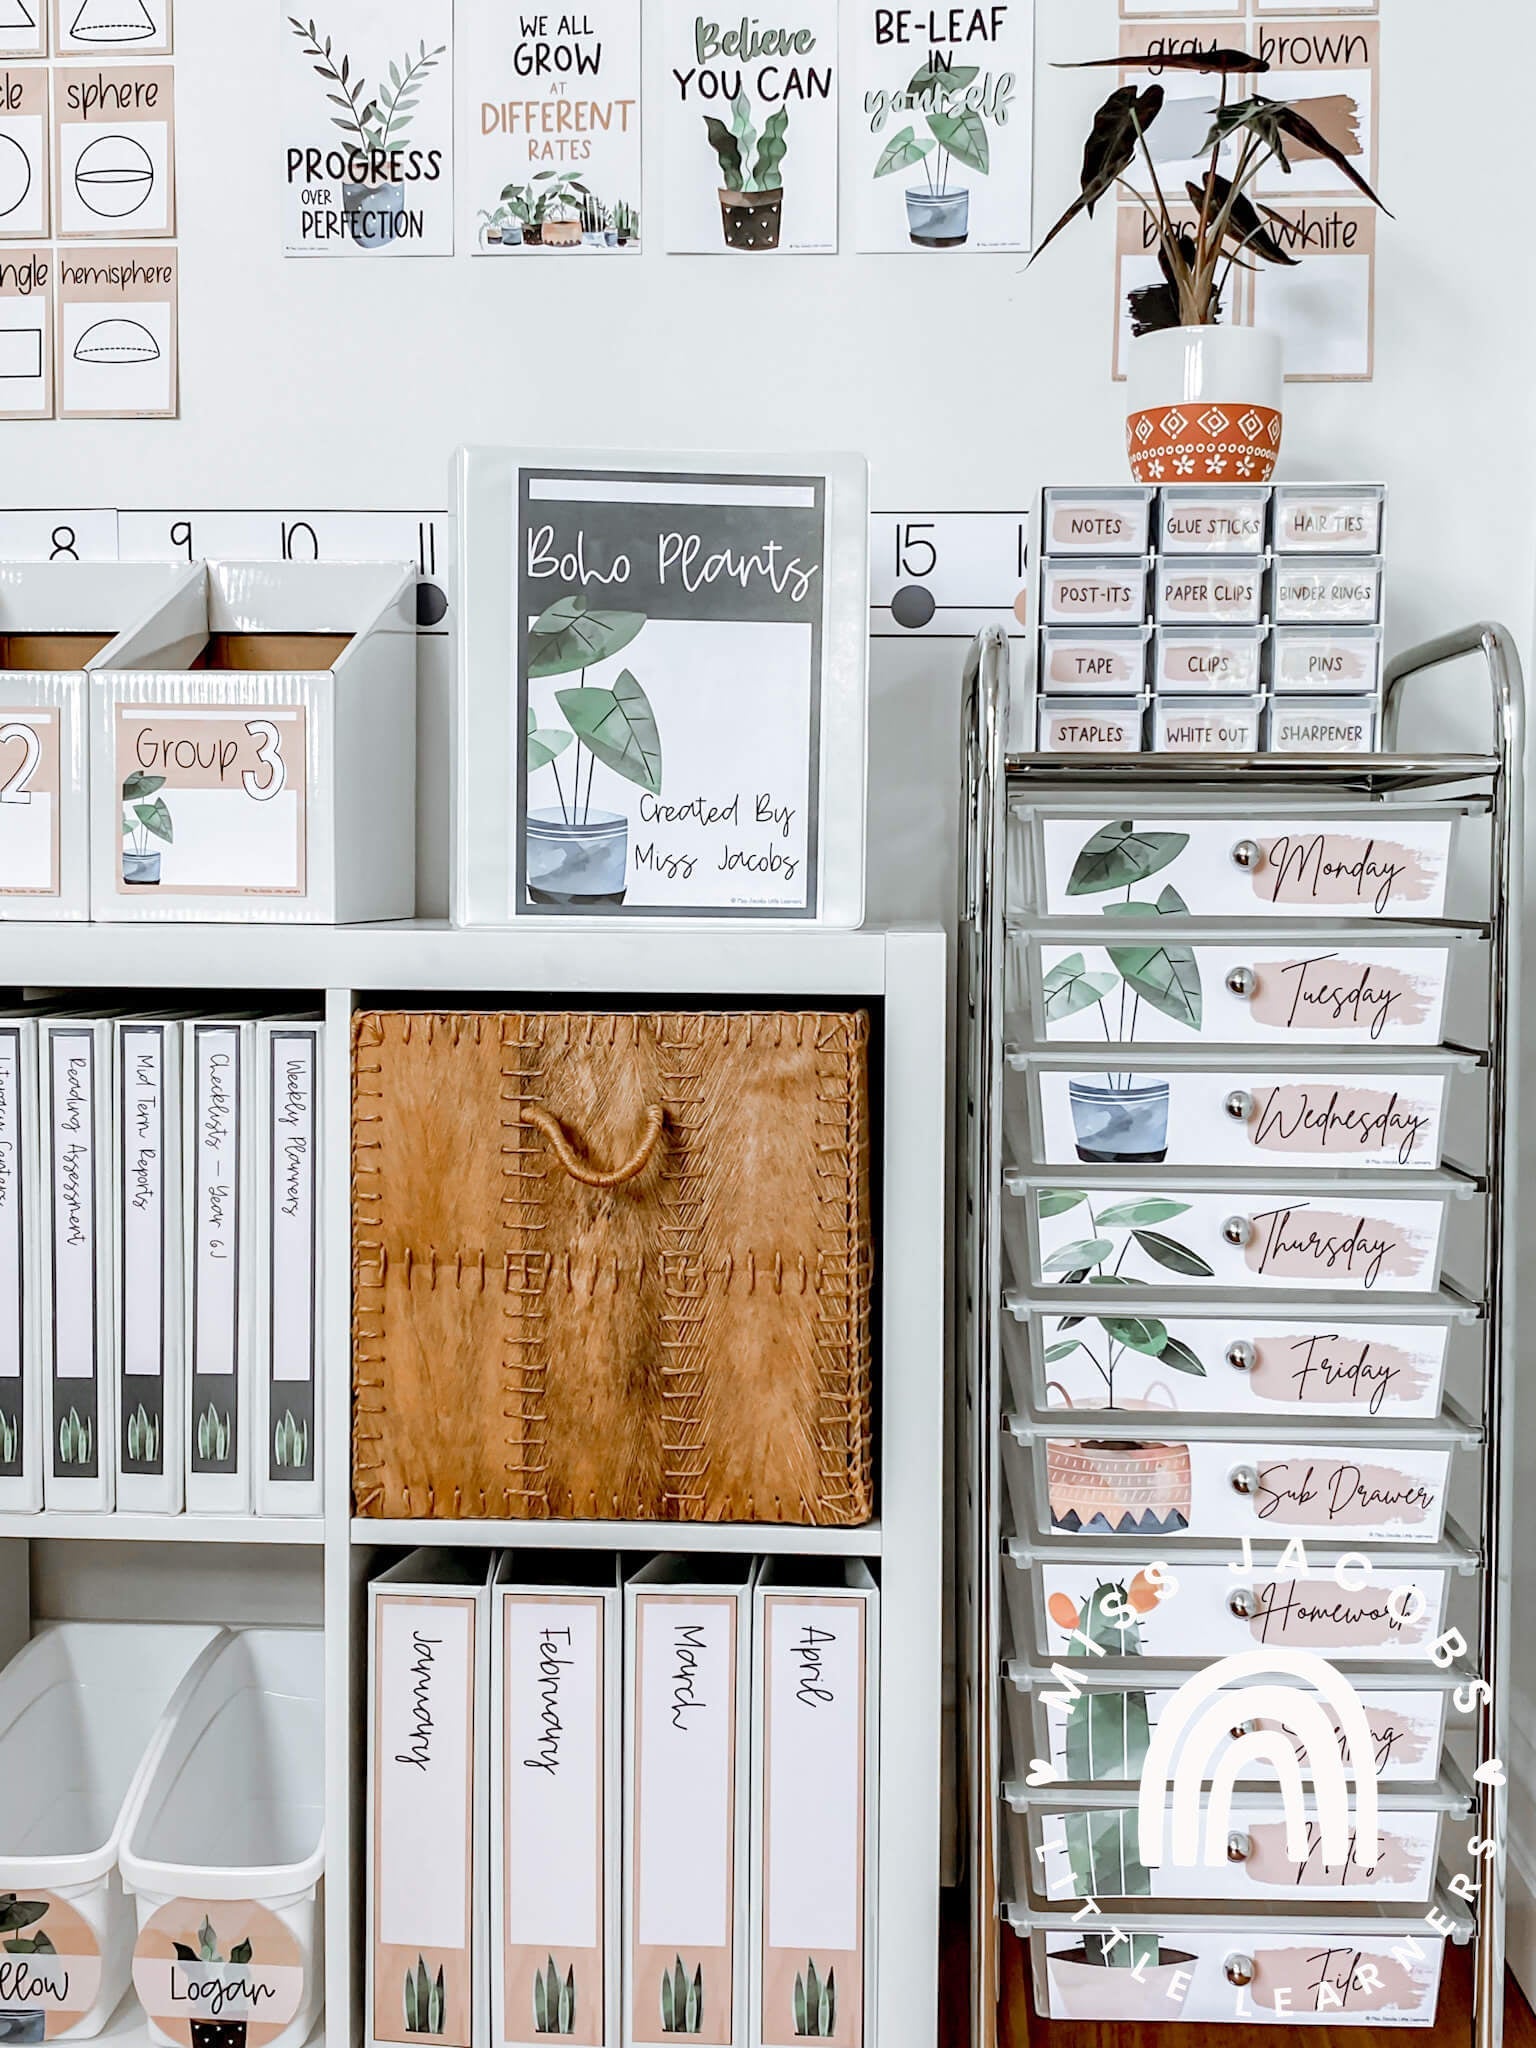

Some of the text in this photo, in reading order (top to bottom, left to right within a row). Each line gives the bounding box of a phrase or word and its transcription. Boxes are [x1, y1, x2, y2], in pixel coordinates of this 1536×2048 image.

[519, 15, 594, 38] WE ALL
[694, 15, 817, 66] Believe
[875, 6, 1008, 45] BE-LEAF
[513, 42, 602, 76] GROW
[928, 49, 953, 74] IN
[1258, 26, 1368, 67] brown
[0, 72, 23, 110] le
[67, 72, 159, 121] sphere
[550, 81, 566, 95] AT
[672, 66, 832, 102] YOU CAN
[864, 72, 1016, 133] yourself
[481, 99, 636, 136] DIFFERENT
[287, 148, 443, 184] PROGRESS
[528, 138, 592, 162] RATES
[301, 189, 332, 205] OVER
[302, 209, 423, 240] PERFECTION
[1270, 209, 1358, 249] white
[61, 259, 172, 291] hemisphere
[1071, 518, 1123, 535] NOTES
[1166, 517, 1261, 536] GLUE STICKS
[1294, 514, 1365, 533] HAIR TIES
[49, 522, 435, 576] 8 9 10 11
[525, 524, 820, 603] Boho Plants
[896, 523, 937, 577] 15
[1060, 586, 1132, 604] POST-ITS
[1165, 584, 1253, 601] PAPER CLIPS
[1279, 585, 1371, 601] BINDER RINGS
[1075, 657, 1113, 675] TAPE
[1187, 655, 1229, 673] CLIPS
[1309, 656, 1343, 673] PINS
[1057, 725, 1124, 743] STAPLES
[1166, 726, 1249, 744] WHITE OUT
[1280, 724, 1363, 742] SHARPENER
[135, 719, 286, 801] Group 3
[640, 793, 796, 838] Created By
[635, 842, 800, 881] Miss Jacobs
[1269, 834, 1406, 914] Monday
[1281, 952, 1402, 1040] Tuesday
[204, 1054, 230, 1149] Checklists
[131, 1055, 156, 1210] Mid Term Reports
[278, 1060, 307, 1217] Weekly Planners
[1254, 1086, 1429, 1165] Wednesday
[61, 1058, 88, 1246] Reading Assessment
[208, 1185, 228, 1228] Year
[1253, 1202, 1396, 1288] Thursday
[1290, 1334, 1401, 1415] Friday
[1258, 1464, 1434, 1520] Sub Drawer
[671, 1625, 707, 1731] March
[790, 1626, 836, 1708] April
[394, 1630, 443, 1772] January
[523, 1626, 574, 1775] February
[171, 1966, 276, 2015] Logan
